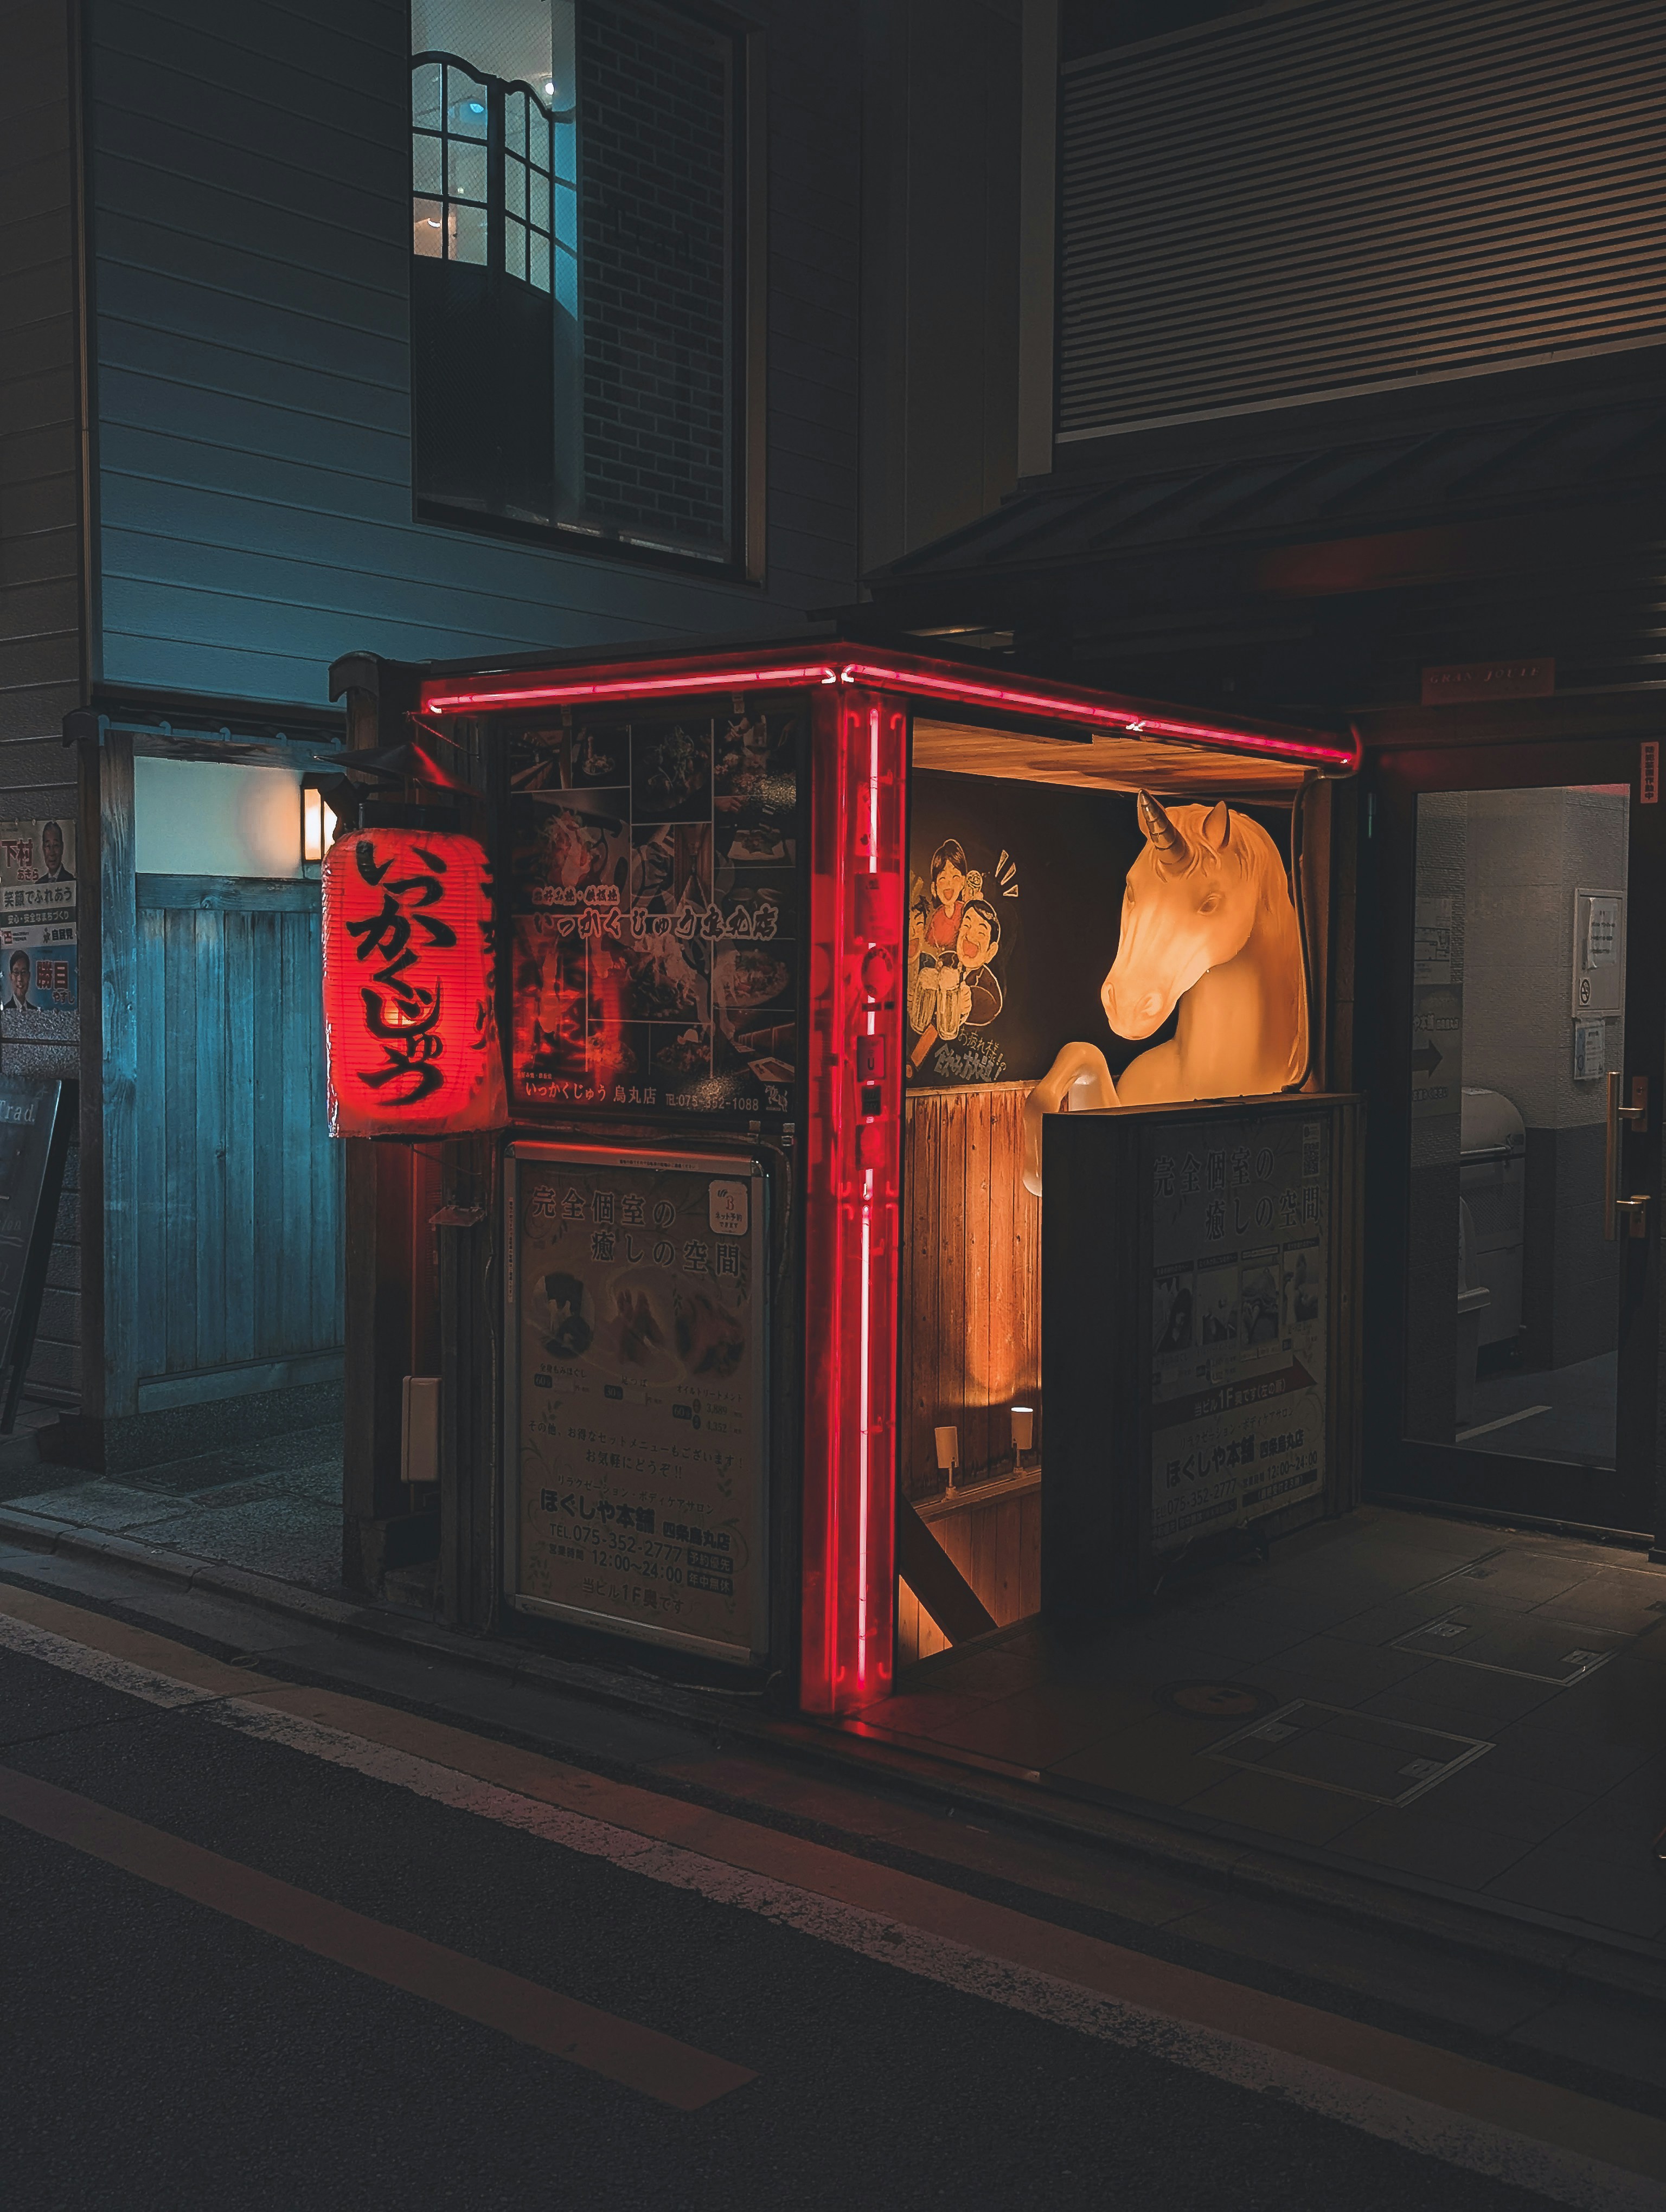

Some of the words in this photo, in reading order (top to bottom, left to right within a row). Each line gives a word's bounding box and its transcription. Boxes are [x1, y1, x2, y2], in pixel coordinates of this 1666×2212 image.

[1, 839, 33, 867] 下村
[17, 868, 39, 881] あきら
[4, 886, 72, 907] 笑顔でふれあう
[8, 911, 69, 924] 安心・安全なまちづくり
[347, 840, 457, 1106] いっかくじゅう
[526, 1082, 606, 1101] いっかくじゅう
[613, 1084, 657, 1104] 烏丸店
[1154, 1147, 1274, 1198] 完全個室の
[533, 1185, 676, 1229] 完全個室の
[715, 1212, 742, 1221] ネット予約
[1205, 1185, 1320, 1241] 癒しの空間
[591, 1230, 741, 1276] 癒しの空間
[540, 1363, 587, 1378] 全身もみほぐし
[677, 1385, 741, 1403] オイルトリートメント
[1166, 1433, 1255, 1489] ほぐしや本舗
[558, 1475, 714, 1514] リラクゼーション・ボディケアサロン
[540, 1488, 655, 1534] ほぐしや本舗
[663, 1521, 731, 1552] 四条烏丸店
[689, 1552, 730, 1571] 予約優先
[689, 1573, 730, 1593] 年中無休
